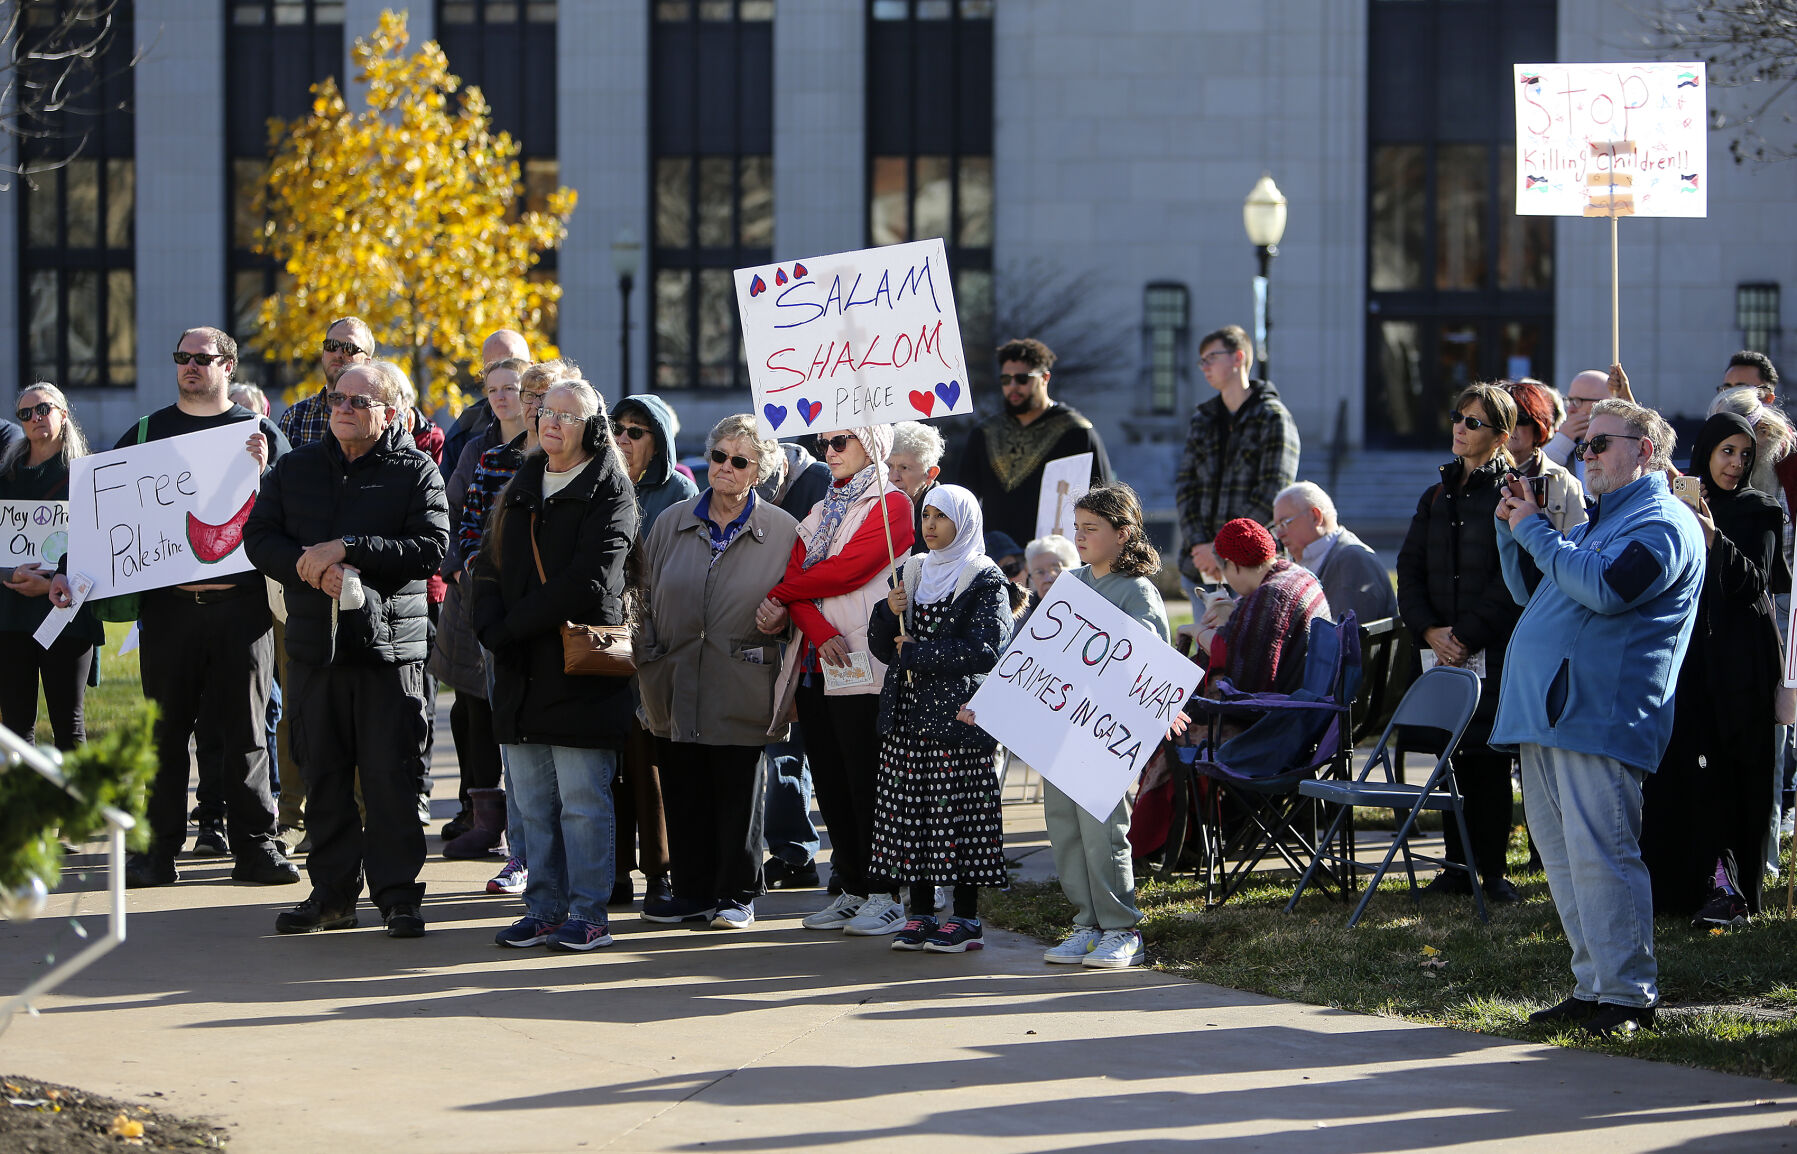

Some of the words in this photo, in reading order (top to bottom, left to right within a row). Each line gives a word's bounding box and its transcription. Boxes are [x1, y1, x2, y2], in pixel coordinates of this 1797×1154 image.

[1524, 149, 1587, 182] Killing
[774, 256, 941, 328] SALAM
[766, 319, 952, 393] SHALOM
[835, 385, 894, 426] PEACE
[0, 505, 29, 531] May
[53, 504, 69, 526] Pr
[93, 461, 197, 530] Free
[10, 533, 35, 556] On
[109, 523, 183, 587] Palestine
[1030, 600, 1133, 677] STOP
[1128, 663, 1184, 722] WAR
[998, 650, 1074, 712] CRIMES
[1069, 697, 1098, 727] IN
[1093, 713, 1142, 771] GAZA
